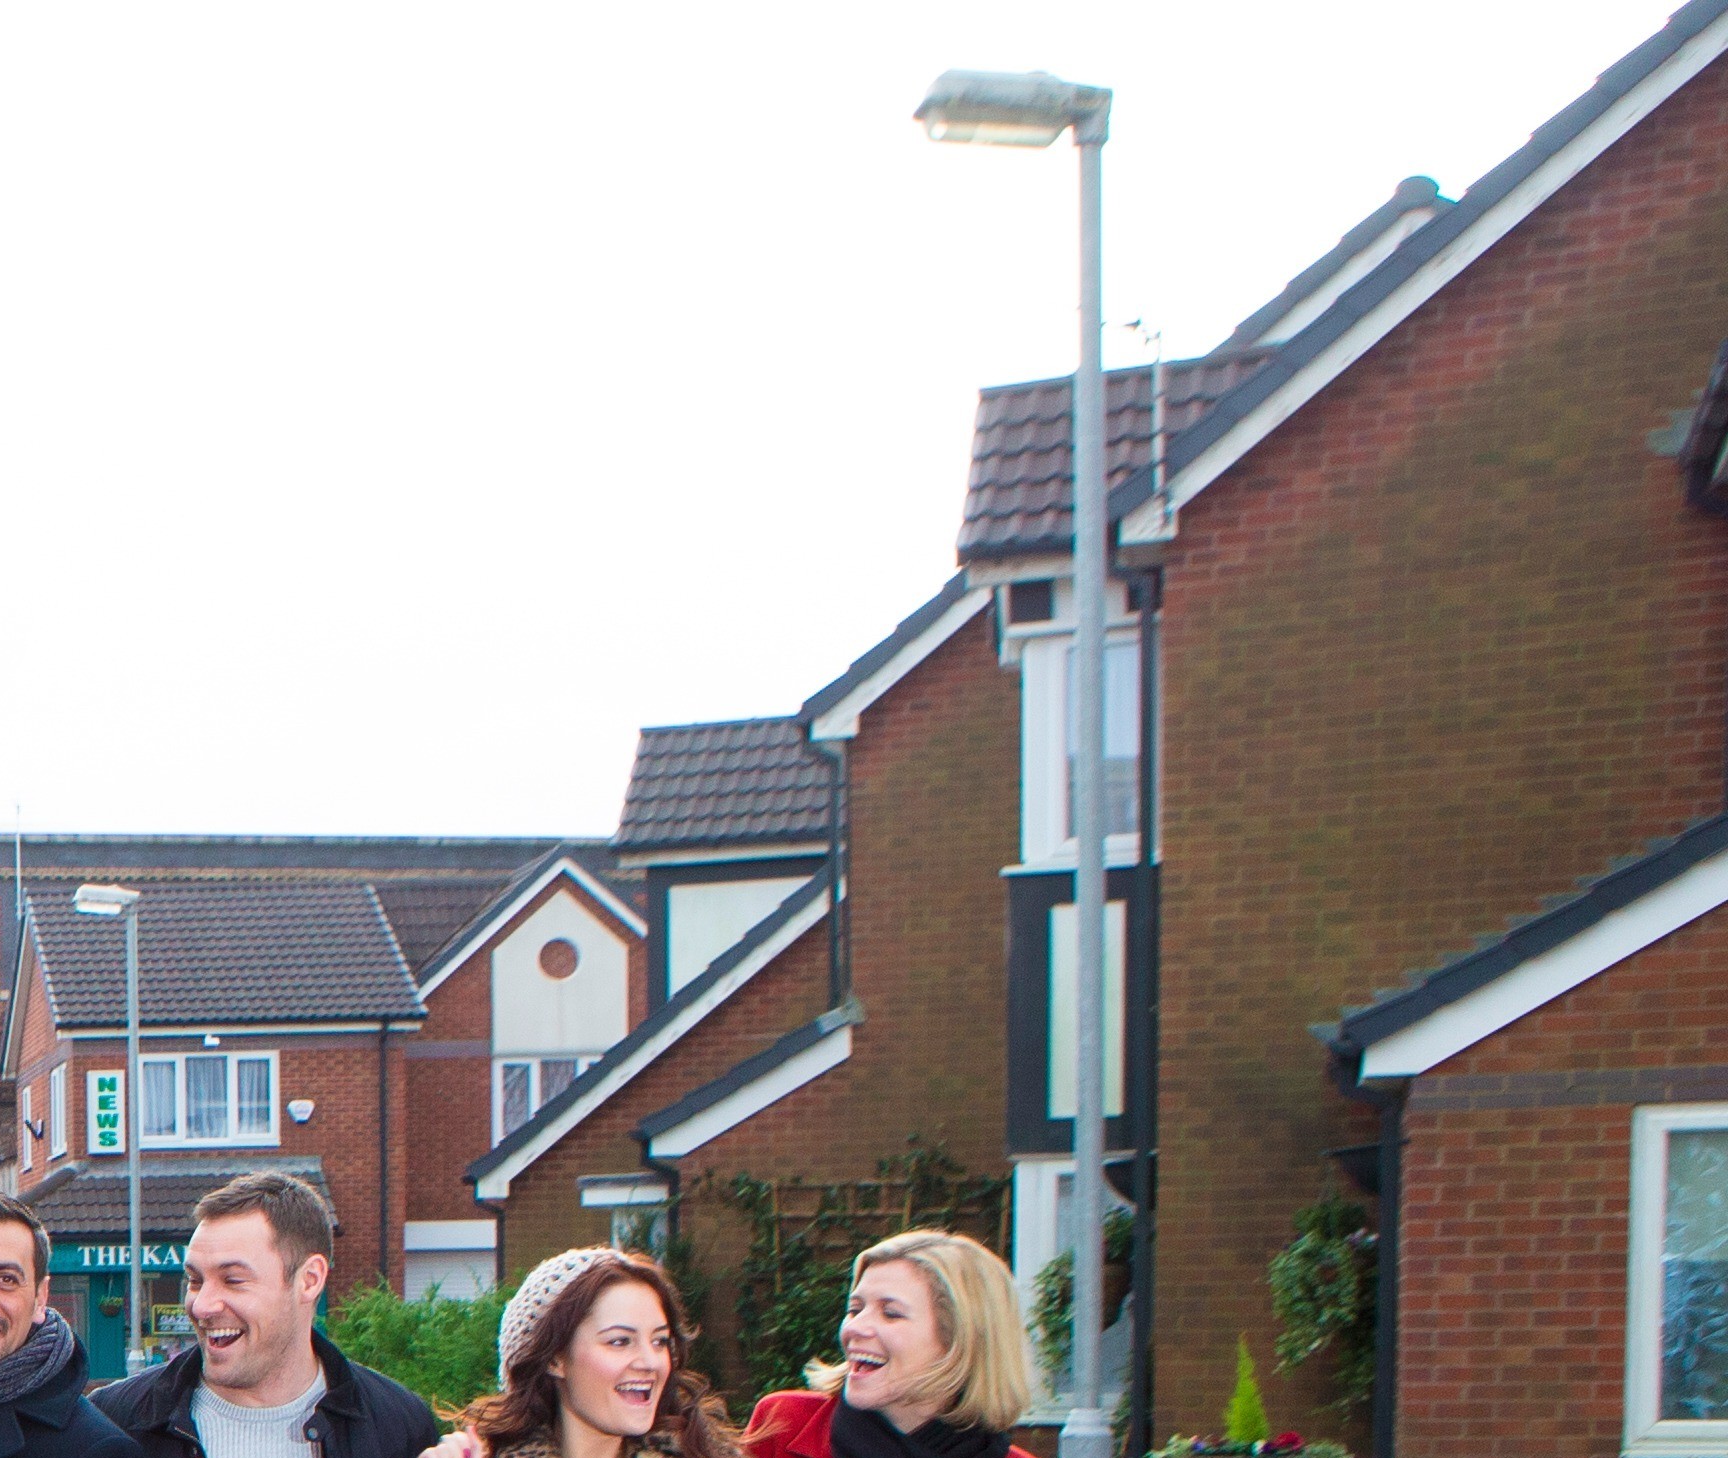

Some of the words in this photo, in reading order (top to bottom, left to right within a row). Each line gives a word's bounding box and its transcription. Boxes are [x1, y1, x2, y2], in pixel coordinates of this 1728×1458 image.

[97, 1076, 119, 1147] NEWS
[77, 1245, 132, 1267] THE
[141, 1245, 189, 1267] KA
